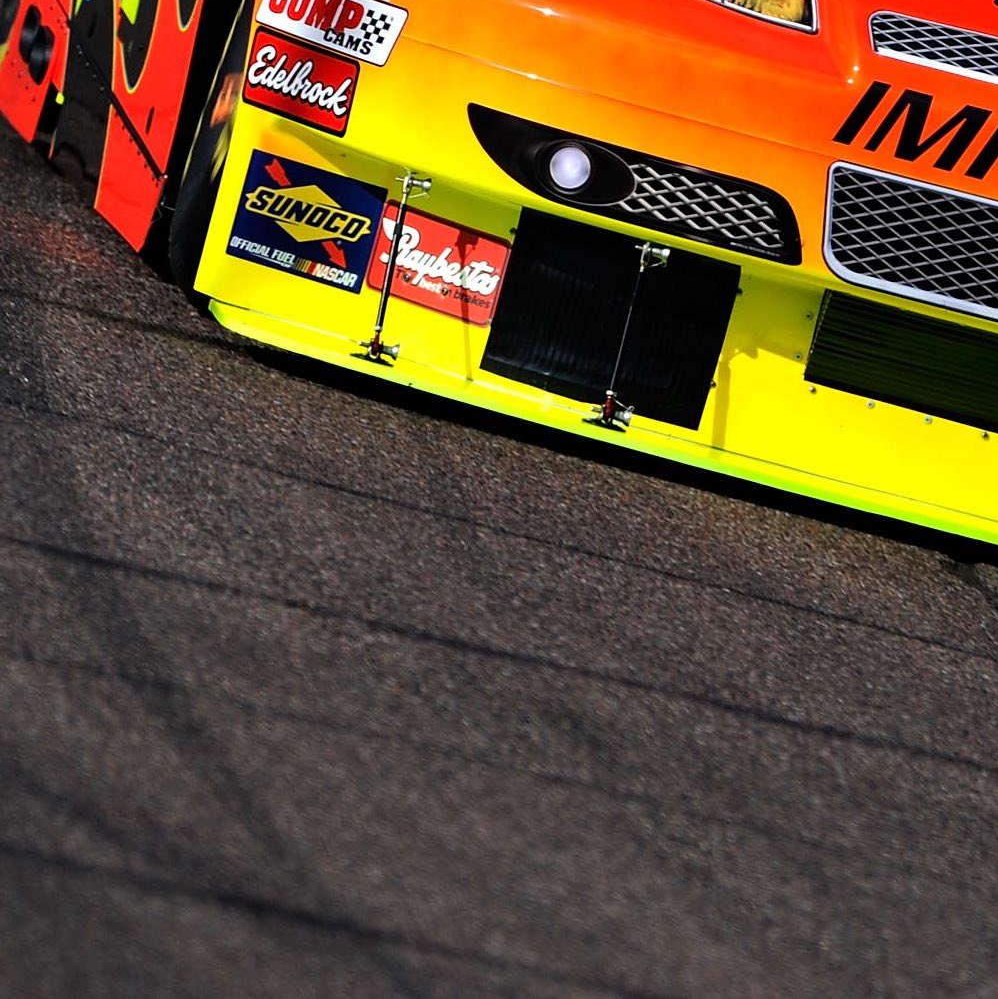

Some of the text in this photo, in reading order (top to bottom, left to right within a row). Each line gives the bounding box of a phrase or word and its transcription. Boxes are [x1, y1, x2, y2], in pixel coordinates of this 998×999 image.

[322, 27, 374, 56] CAMS
[248, 45, 352, 117] Edelbrock
[250, 189, 367, 239] SUNOCO
[229, 235, 297, 265] OFFICIAL FUEL
[312, 263, 358, 288] NASCAR
